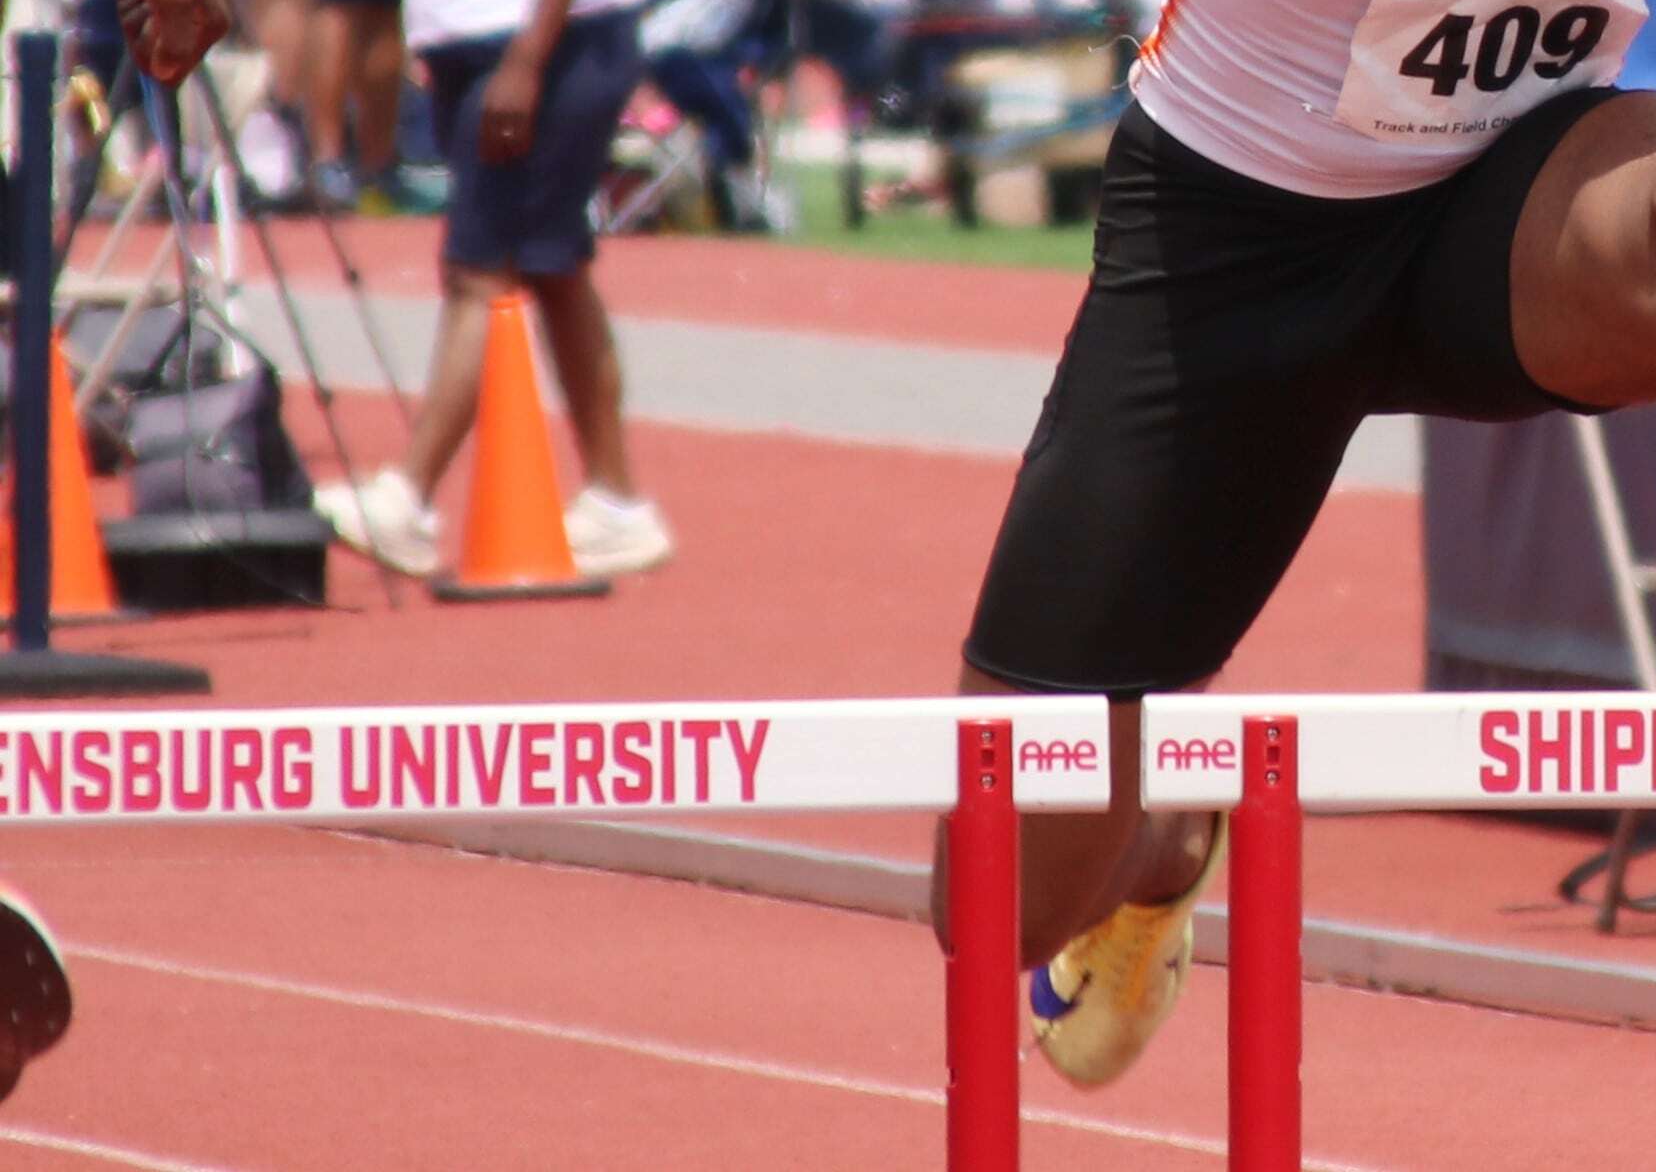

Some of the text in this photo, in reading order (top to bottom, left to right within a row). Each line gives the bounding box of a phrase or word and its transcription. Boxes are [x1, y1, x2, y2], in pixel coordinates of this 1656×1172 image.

[1399, 5, 1610, 96] 409
[1374, 119, 1415, 133] Track
[1419, 122, 1448, 134] and
[1451, 118, 1487, 134] Field
[0, 719, 771, 815] NSBURG UNIVERSITY
